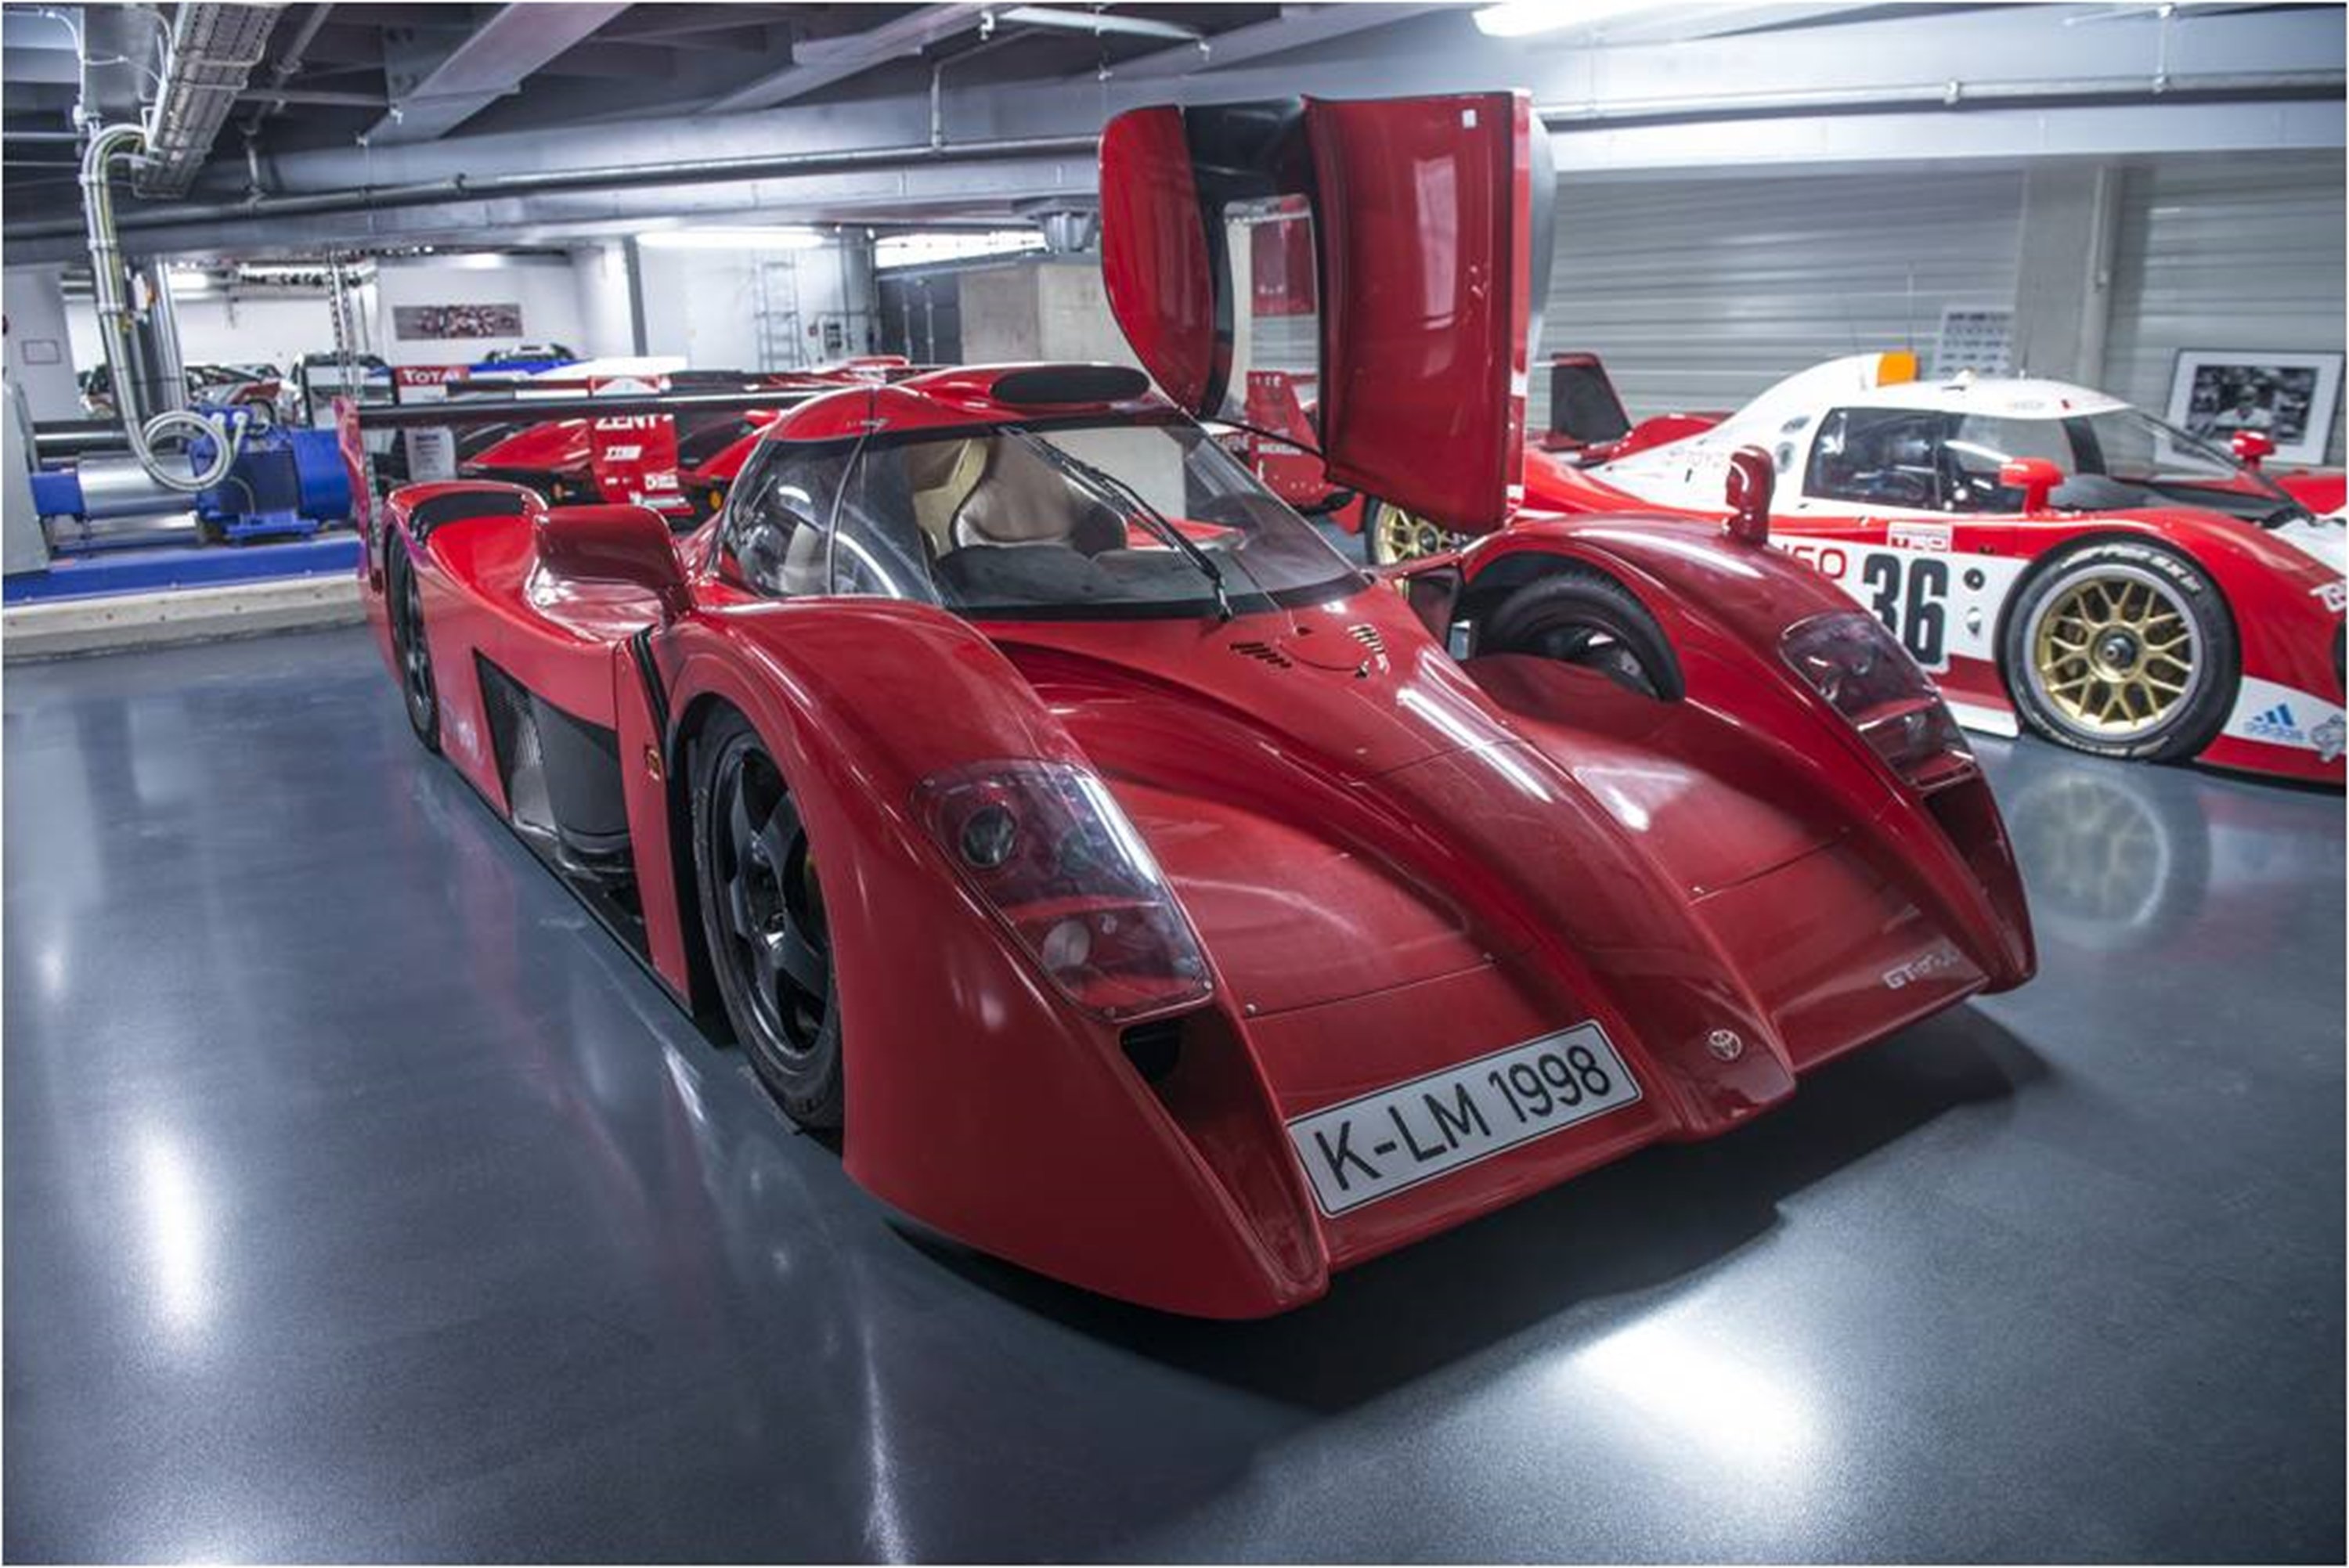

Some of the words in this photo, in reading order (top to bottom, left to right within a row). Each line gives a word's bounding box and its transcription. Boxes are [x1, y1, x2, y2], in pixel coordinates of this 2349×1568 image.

[1863, 553, 1949, 665] 36
[1314, 1082, 1492, 1191] K-LM
[1488, 1044, 1612, 1123] 1998
